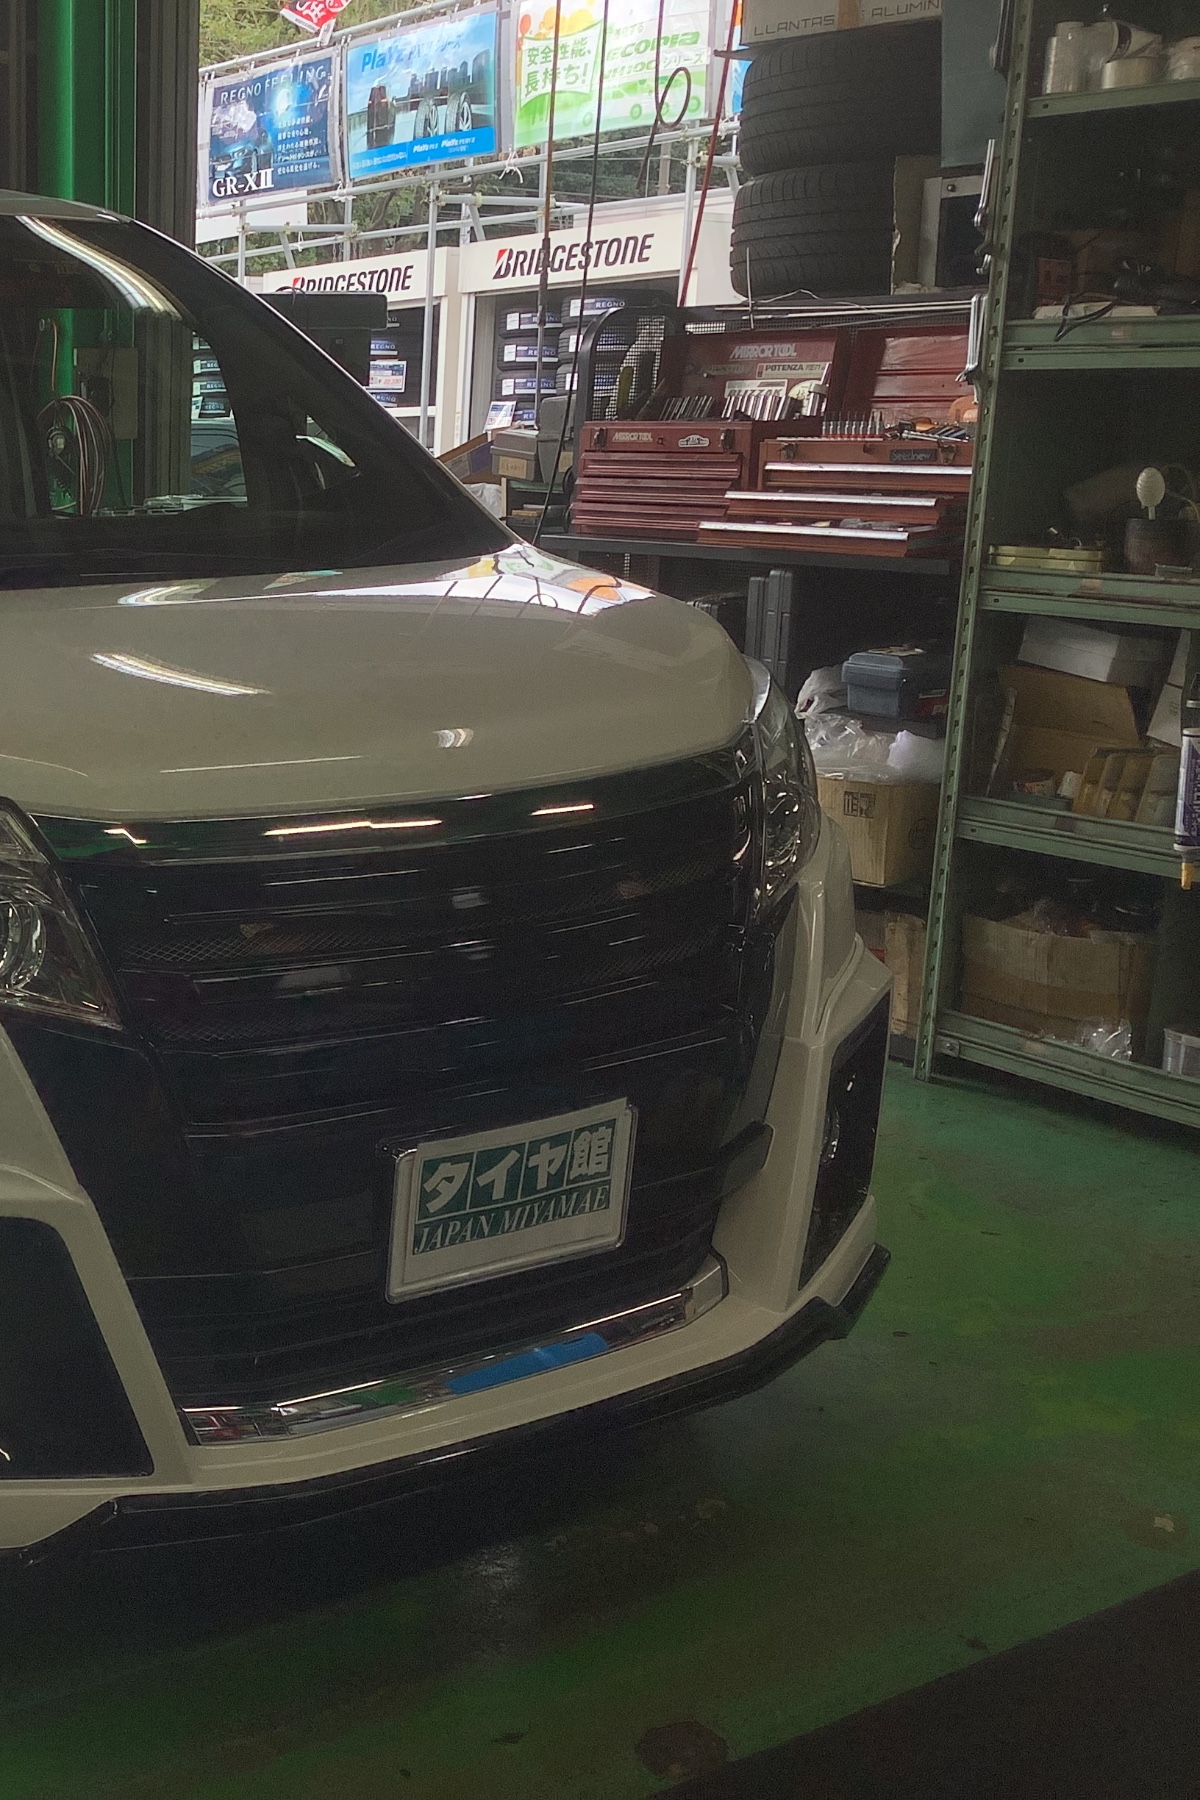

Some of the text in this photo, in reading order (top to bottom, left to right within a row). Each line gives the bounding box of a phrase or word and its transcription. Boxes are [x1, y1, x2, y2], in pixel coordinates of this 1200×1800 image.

[754, 14, 835, 36] LLANTAS
[662, 52, 705, 69] シリーズ
[220, 82, 262, 105] REGNO
[765, 363, 804, 371] POTENZA
[423, 1126, 614, 1214] タイヤ館
[414, 1184, 610, 1255] JAPAN MIYAMAE
